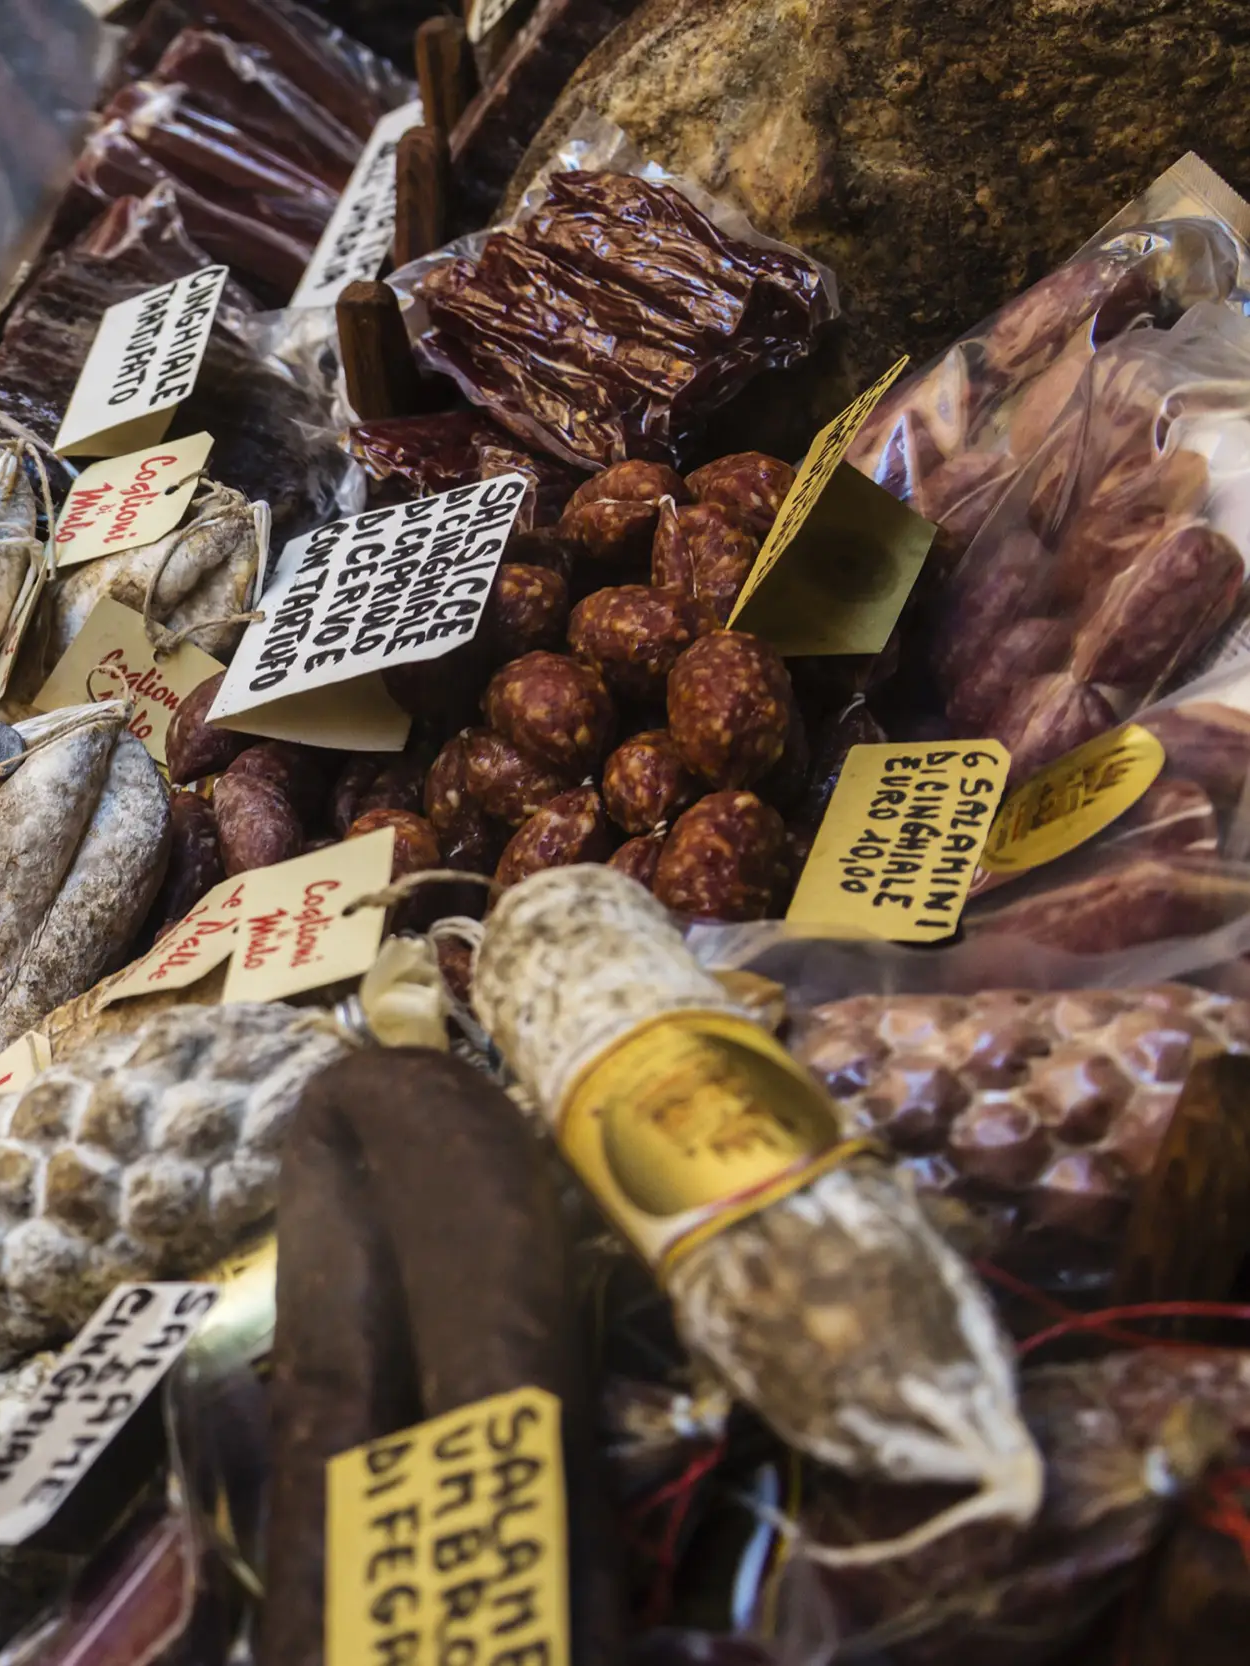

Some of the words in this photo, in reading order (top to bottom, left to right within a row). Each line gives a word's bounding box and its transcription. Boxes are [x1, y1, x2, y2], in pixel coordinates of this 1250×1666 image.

[107, 282, 181, 407] TARTUFATO
[149, 266, 222, 407] CINGHIALE
[56, 482, 114, 543] Mulo
[103, 456, 177, 543] Coglioni
[351, 509, 396, 541] DI
[402, 497, 441, 519] DI
[445, 485, 480, 507] DI
[295, 521, 349, 575] CON
[425, 481, 525, 642] SALSICCE
[312, 544, 385, 645] CERVO
[350, 527, 433, 656] CAPRIOLO
[383, 512, 471, 657] CINGHIALE
[249, 569, 330, 691] TARTUFO
[303, 647, 346, 673] E
[99, 648, 181, 711] Coglion
[867, 756, 923, 820] EURO
[920, 752, 960, 774] DI
[962, 752, 998, 768] 6
[838, 829, 891, 893] 10,00
[872, 781, 943, 909] CINGHIALE
[915, 778, 994, 928] SALAMINI
[148, 917, 241, 982] Palle
[243, 908, 288, 970] Mulo
[290, 879, 341, 969] Coglioni
[23, 1288, 218, 1504] SALAME
[362, 1442, 416, 1498] DI
